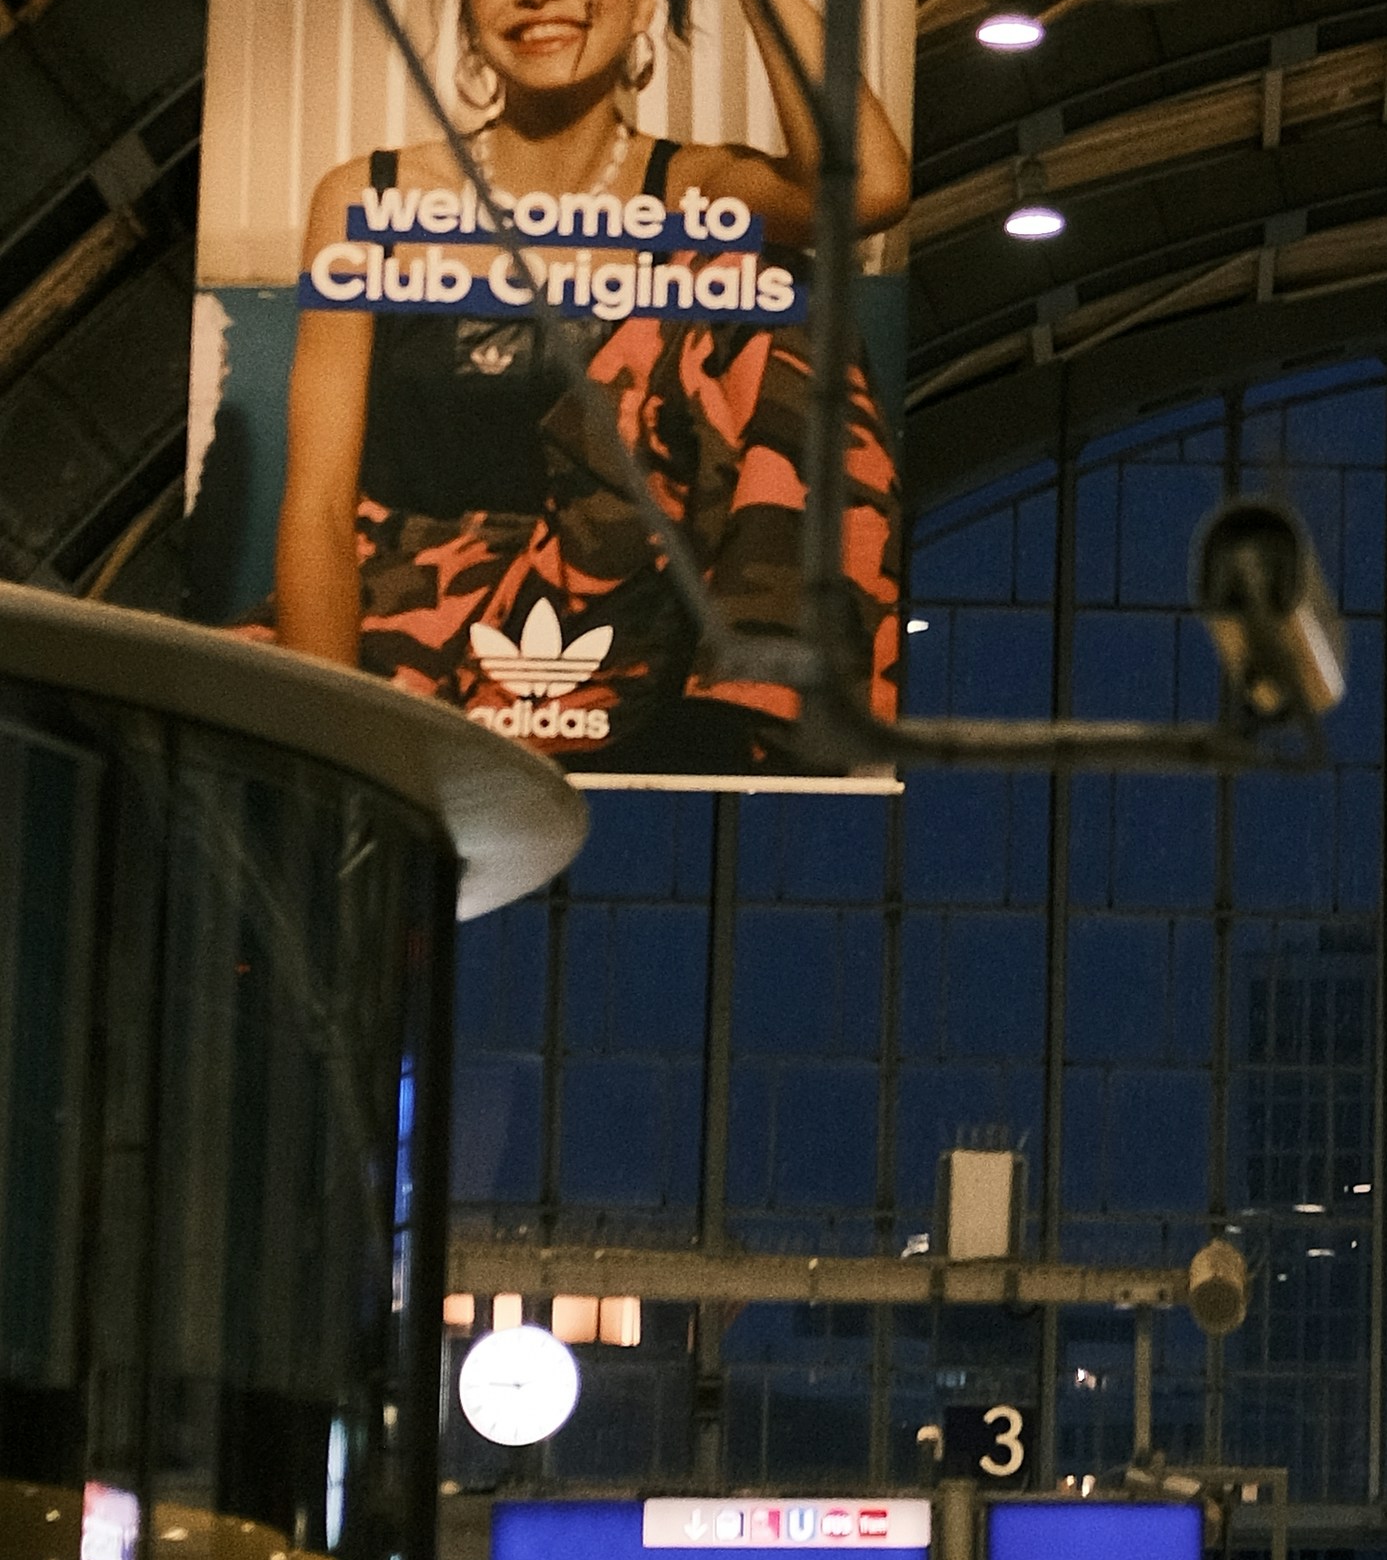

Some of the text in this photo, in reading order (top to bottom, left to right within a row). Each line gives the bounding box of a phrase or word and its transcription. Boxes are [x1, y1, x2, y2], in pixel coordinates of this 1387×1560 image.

[679, 186, 751, 242] to
[310, 240, 796, 321] Club Originals
[978, 1403, 1026, 1478] 3
[788, 1507, 814, 1541] U
